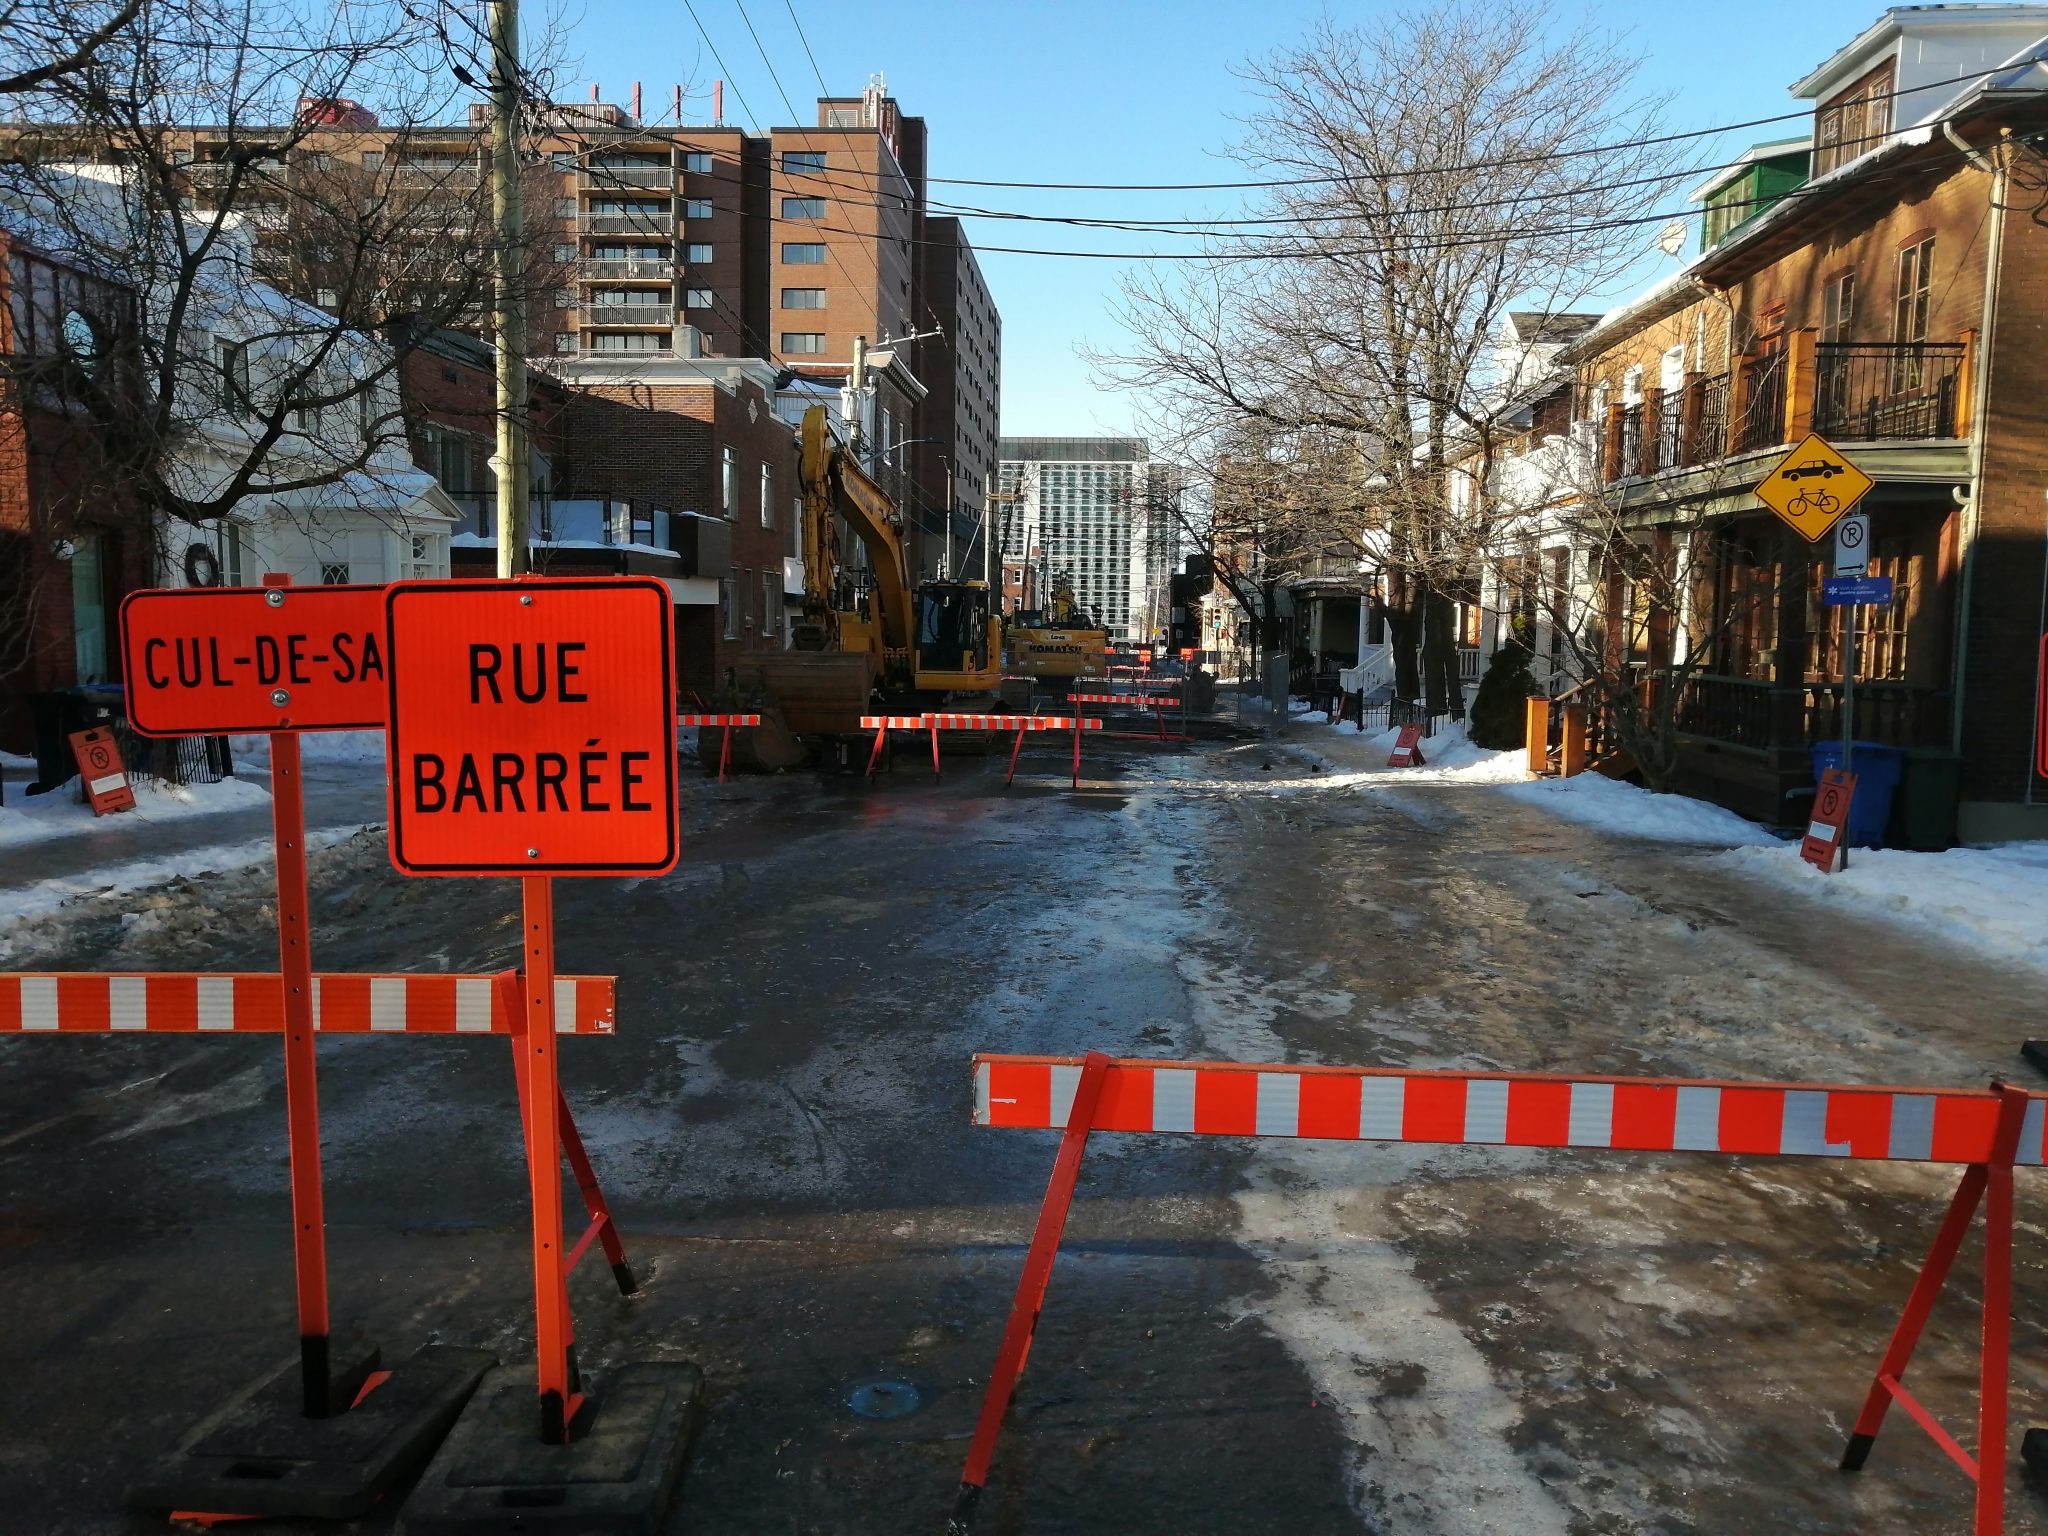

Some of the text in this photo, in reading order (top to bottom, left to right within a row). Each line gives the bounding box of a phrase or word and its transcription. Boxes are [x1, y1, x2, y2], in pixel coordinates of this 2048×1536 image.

[145, 632, 384, 689] CUL-DE-SA
[468, 641, 589, 704] RUE
[1029, 643, 1082, 654] KOMATSU
[412, 738, 653, 813] BARRÉE
